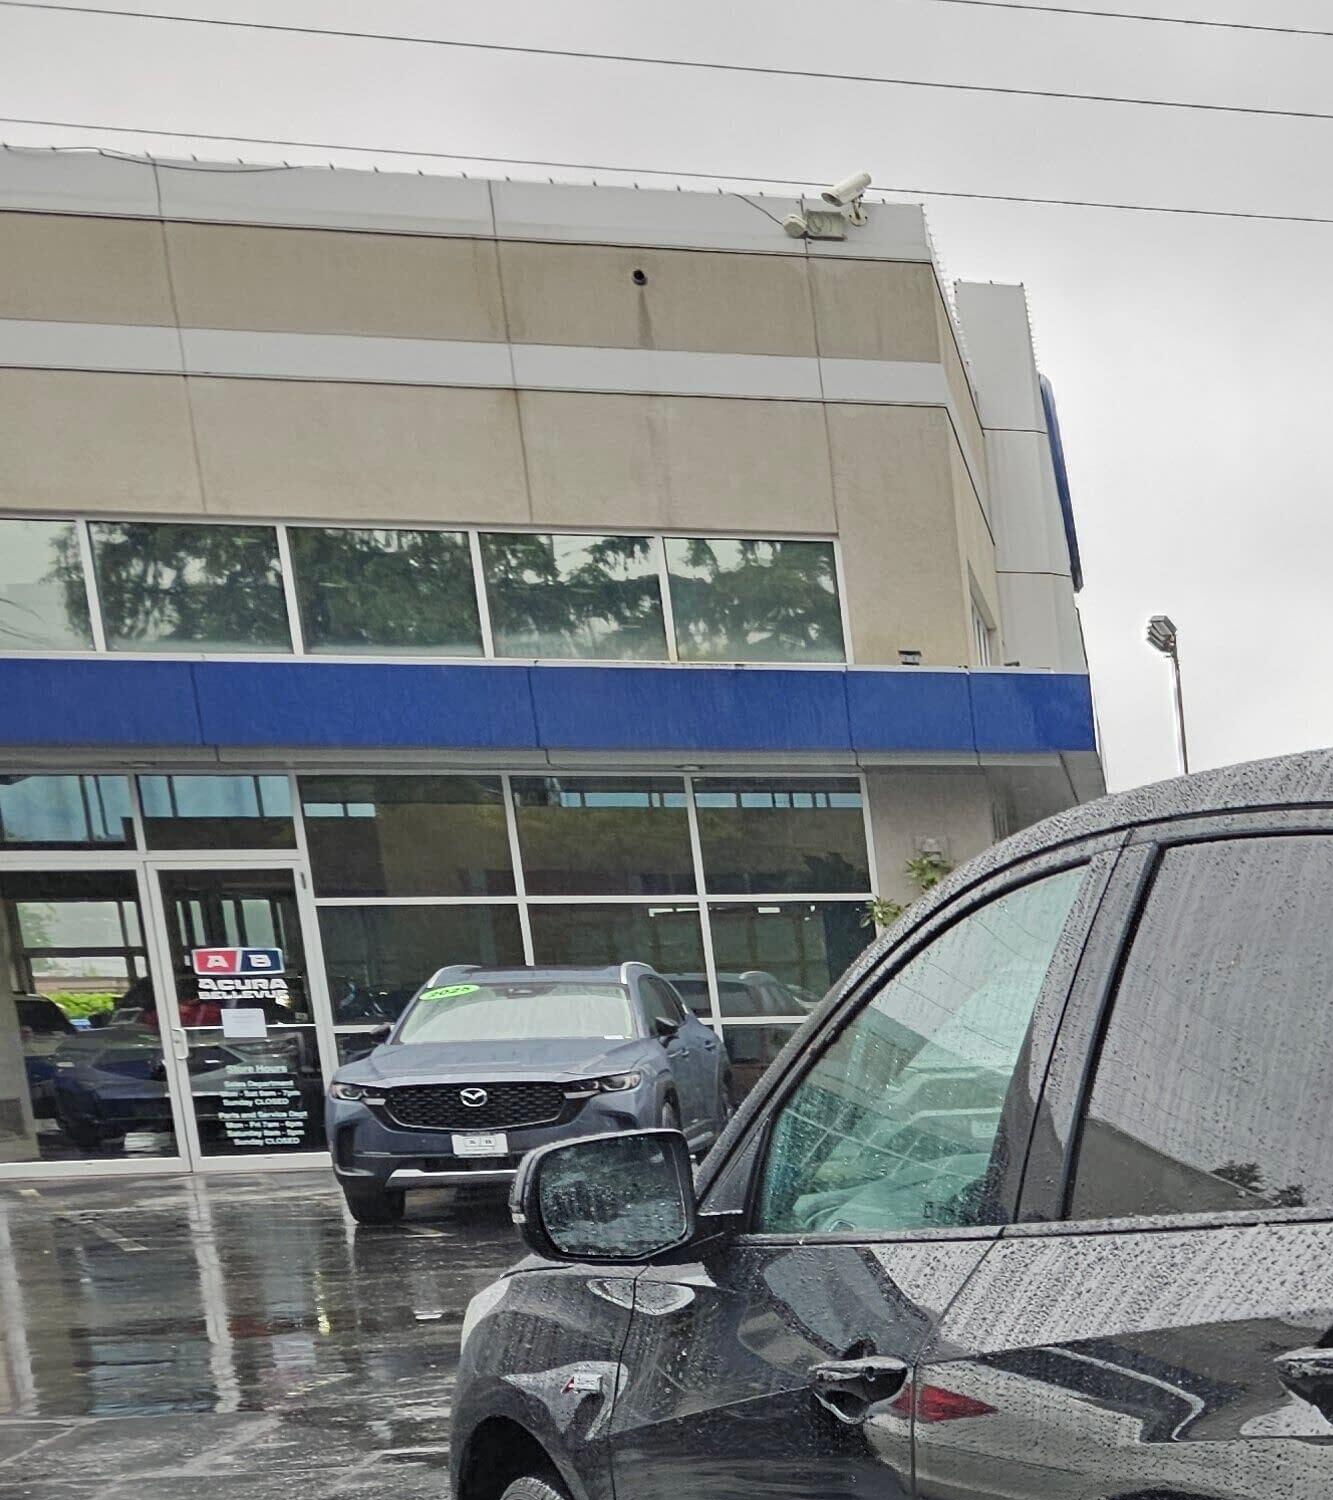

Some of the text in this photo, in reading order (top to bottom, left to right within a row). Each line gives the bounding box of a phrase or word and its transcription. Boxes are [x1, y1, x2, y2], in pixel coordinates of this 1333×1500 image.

[206, 954, 272, 969] A B
[198, 978, 288, 990] ACURA
